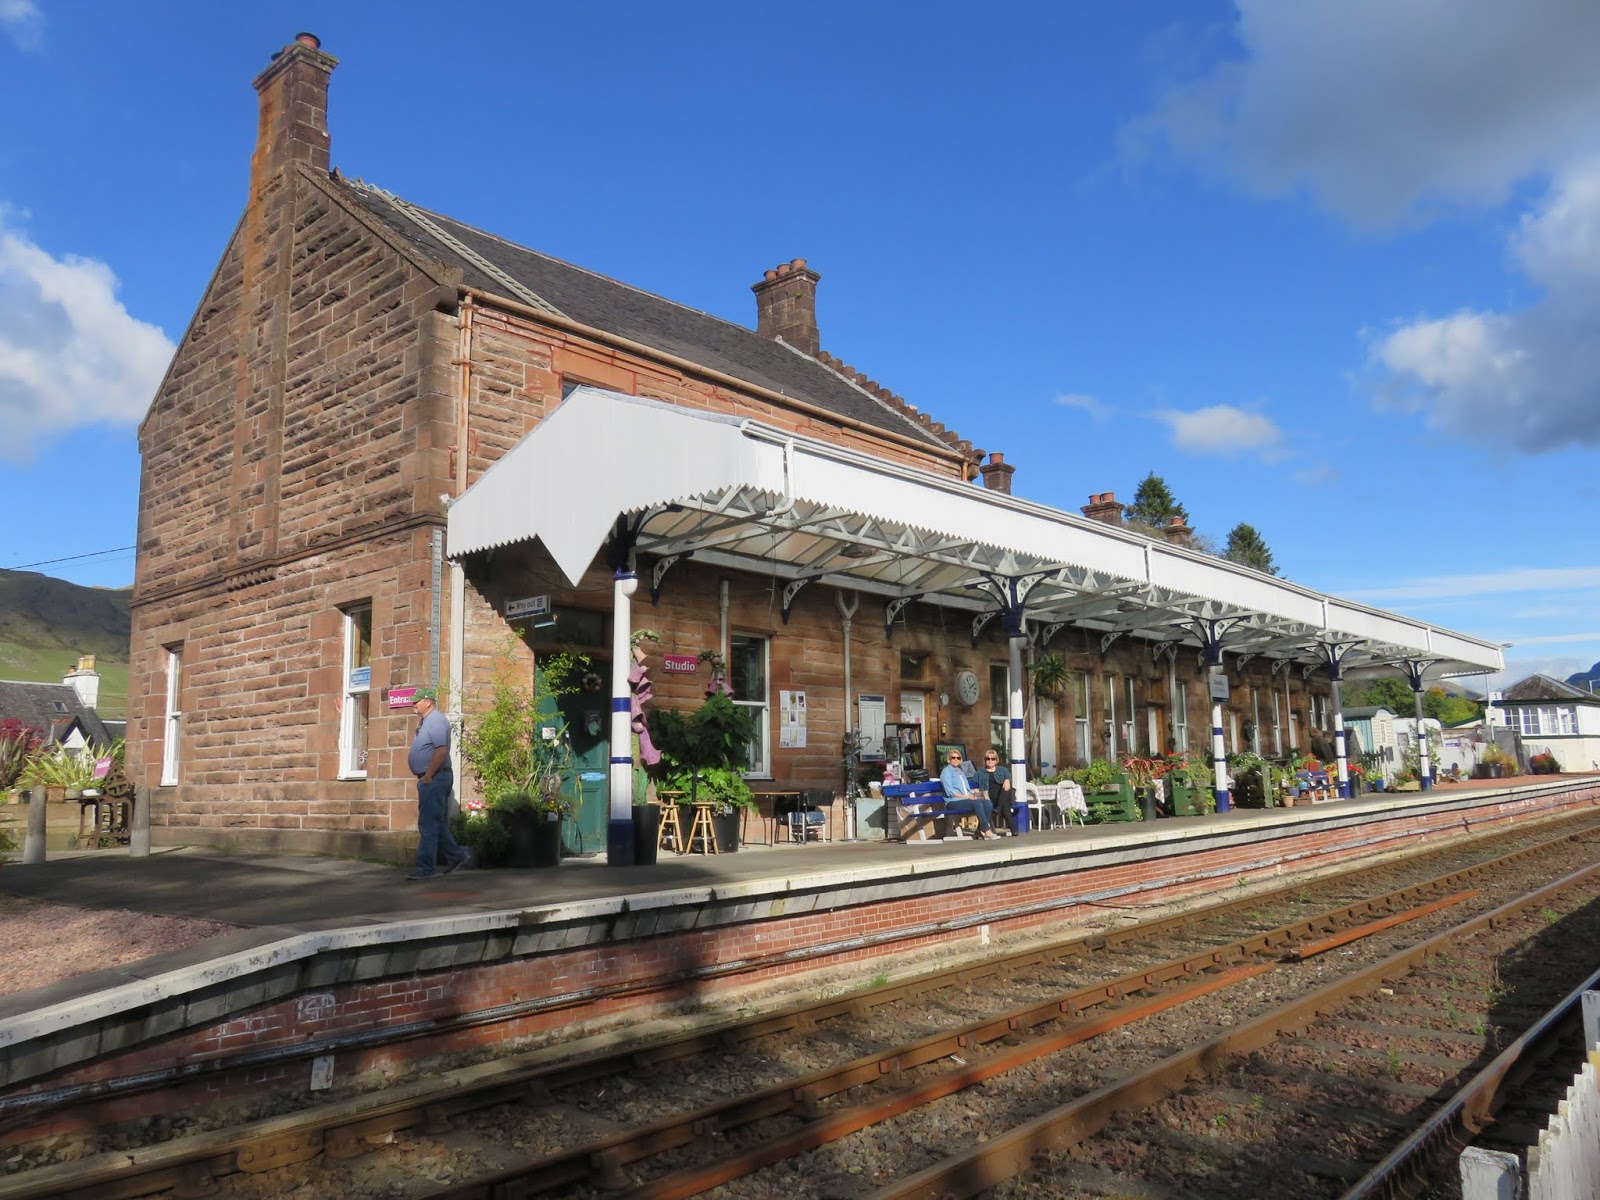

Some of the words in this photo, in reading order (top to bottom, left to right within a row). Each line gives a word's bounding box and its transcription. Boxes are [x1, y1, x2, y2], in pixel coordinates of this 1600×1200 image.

[516, 602, 526, 611] Way
[527, 600, 536, 608] out
[664, 660, 696, 671] Studio
